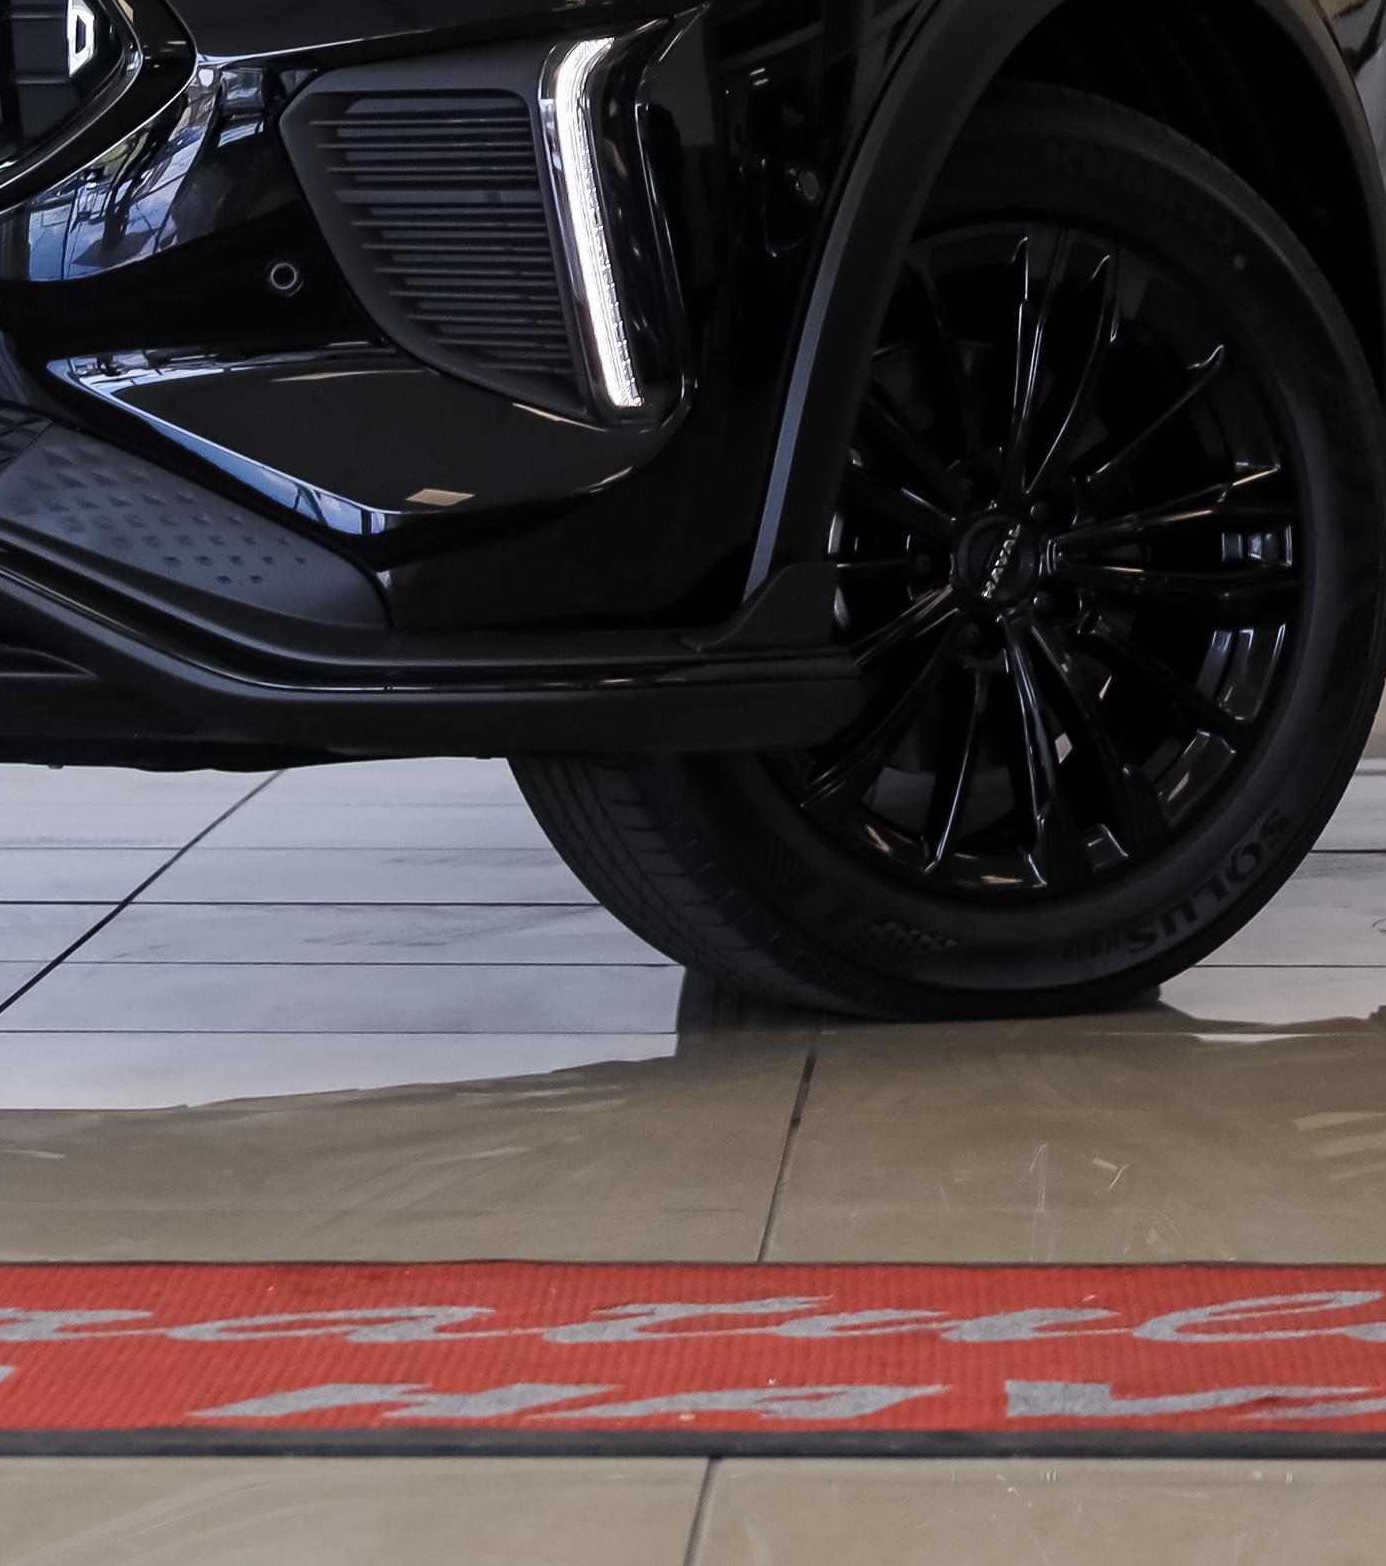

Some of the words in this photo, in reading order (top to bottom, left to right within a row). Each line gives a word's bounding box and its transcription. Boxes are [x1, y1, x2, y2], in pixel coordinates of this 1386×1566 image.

[1044, 142, 1237, 246] KUMHO
[981, 522, 1022, 600] HAVAL
[1121, 806, 1290, 955] SOLUS
